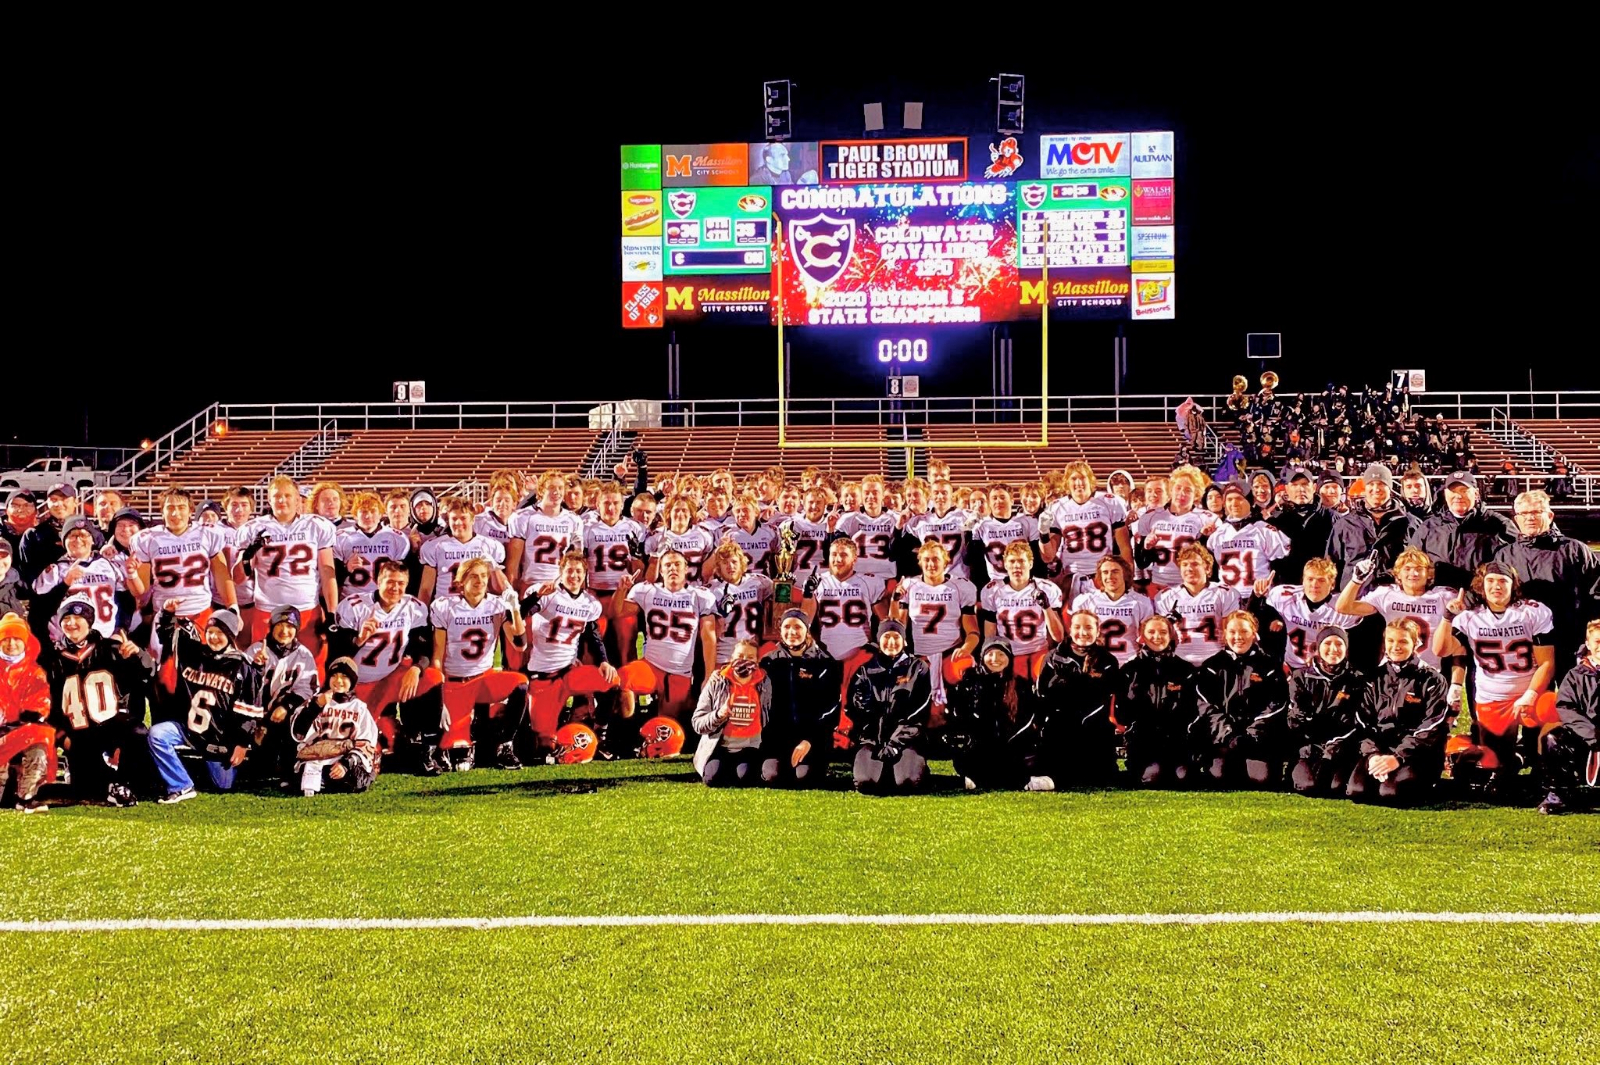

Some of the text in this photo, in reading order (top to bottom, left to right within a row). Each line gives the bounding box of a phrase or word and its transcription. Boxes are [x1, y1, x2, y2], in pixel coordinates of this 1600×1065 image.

[838, 144, 948, 163] PAUL BROWN
[1046, 142, 1123, 166] MCTV
[1133, 154, 1172, 162] AULTMAN
[666, 155, 692, 177] M
[828, 160, 959, 179] TIGER STADIUM
[875, 225, 994, 243] COLDWATER
[698, 287, 770, 301] Massillon
[1019, 280, 1049, 305] M
[1052, 280, 1129, 296] Massillon
[665, 286, 694, 310] M
[1057, 298, 1122, 307] CITY SCHOOLS
[702, 305, 764, 313] CITY SCHOOLS
[808, 309, 867, 325] STATE
[878, 338, 928, 363] 0:00
[890, 379, 899, 394] 8
[1396, 373, 1405, 389] 7
[397, 384, 406, 400] 9
[1064, 511, 1101, 520] COLDWATER
[535, 524, 569, 534] COLDWATER
[858, 523, 891, 532] COLDWATER
[925, 523, 957, 532] COLDWATER
[988, 528, 1024, 539] COLDWATER
[1156, 523, 1193, 533] COLDWATER
[1062, 522, 1109, 554] 88
[1222, 540, 1255, 549] COLDWATER
[158, 542, 200, 556] COLDWATER
[855, 533, 891, 560] 13
[262, 544, 314, 577] 72
[444, 550, 482, 560] COLDWATER
[593, 544, 629, 572] 19
[153, 554, 209, 588] 52
[1220, 551, 1255, 586] 51
[823, 588, 860, 597] COLDWATER
[915, 592, 952, 602] COLDWATER
[555, 604, 590, 617] COLDWATER
[652, 597, 690, 608] COLDWATER
[1001, 598, 1037, 608] COLDWATER
[1391, 601, 1437, 614] COLDWATER
[818, 600, 867, 628] 56
[920, 603, 947, 634] 7
[1095, 607, 1133, 616] COLDWATER
[454, 615, 495, 625] COLDWATER
[647, 609, 696, 643] 65
[724, 602, 763, 638] 78
[998, 609, 1040, 642] 16
[545, 615, 587, 645] 17
[1100, 619, 1128, 652] 2
[1478, 625, 1525, 637] COLDWATER
[361, 630, 403, 667] 71
[461, 628, 489, 661] 3
[1474, 638, 1534, 674] 53
[62, 670, 118, 730] 40
[188, 689, 216, 734] 6
